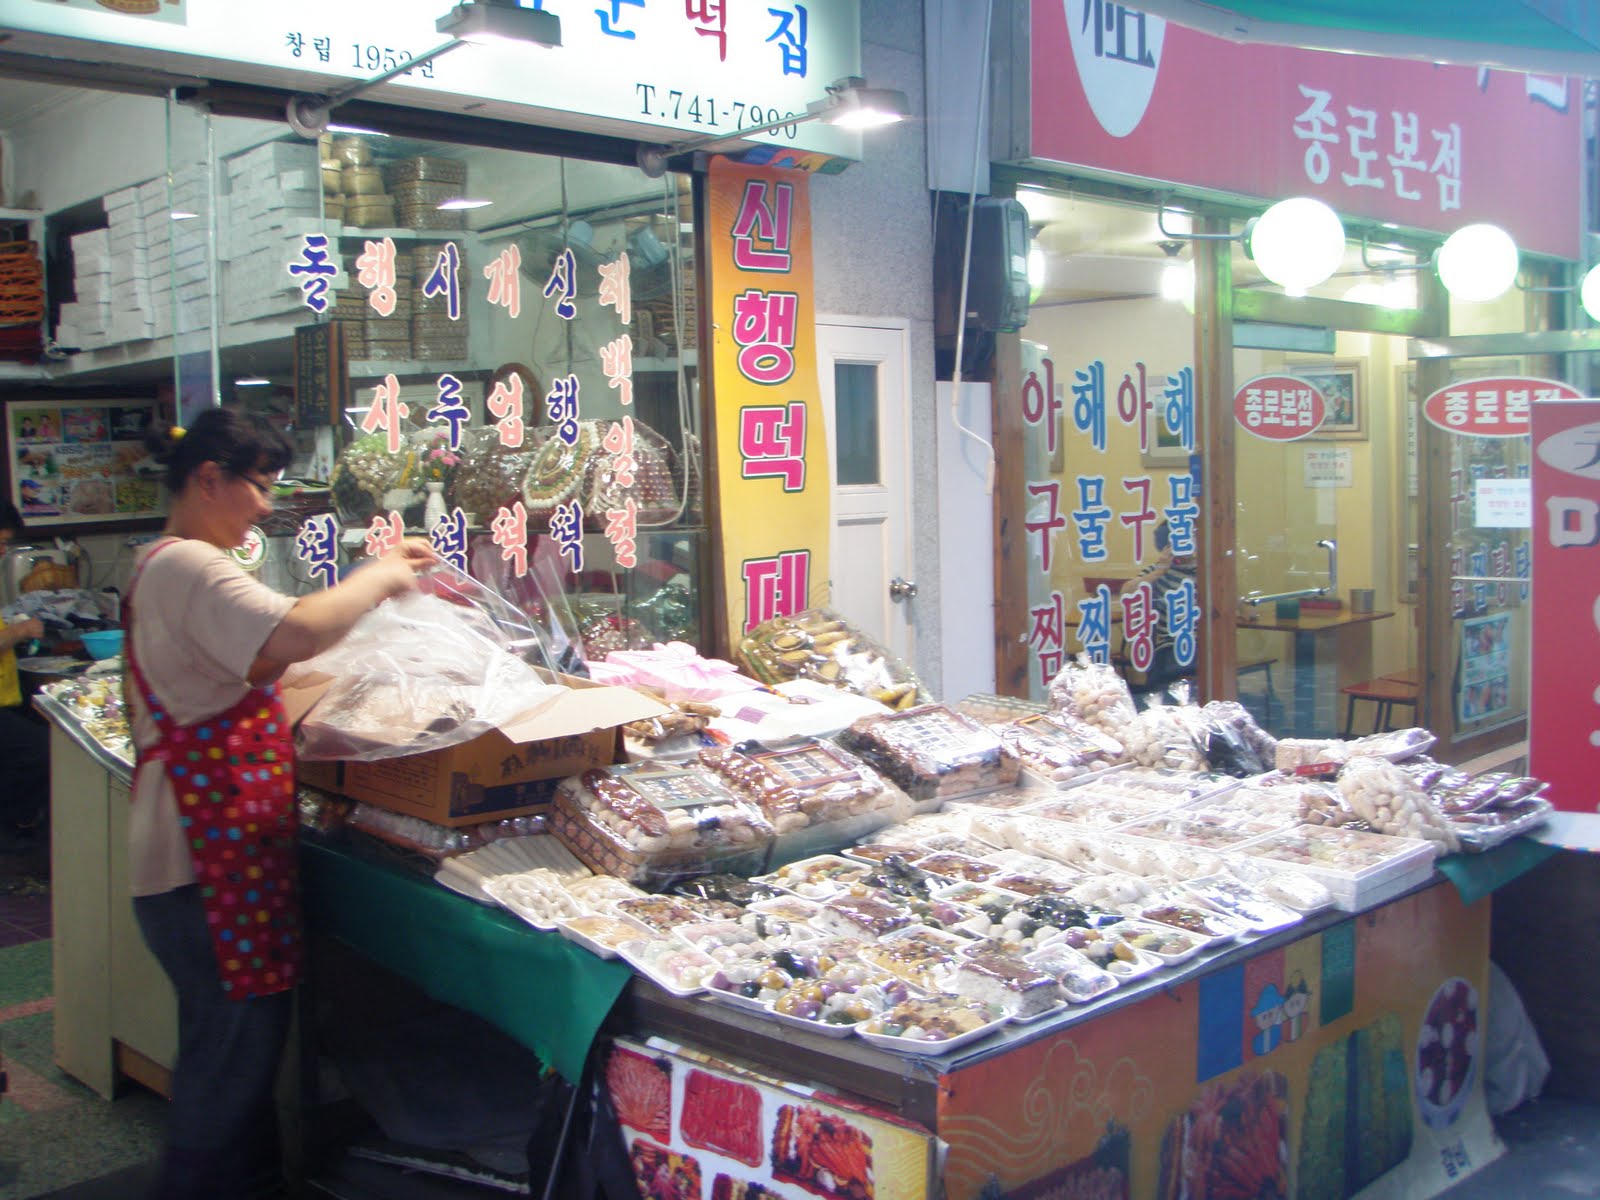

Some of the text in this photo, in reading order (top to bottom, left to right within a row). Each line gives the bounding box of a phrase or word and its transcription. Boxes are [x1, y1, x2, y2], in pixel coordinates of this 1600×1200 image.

[285, 31, 332, 63] 창립
[1293, 83, 1461, 212] 종로본점
[732, 179, 807, 493] 신행떡
[1244, 388, 1313, 427] 종로본점
[1444, 389, 1561, 425] 종로본
[1117, 361, 1159, 672] 아구탕
[1163, 365, 1200, 666] 해물탕
